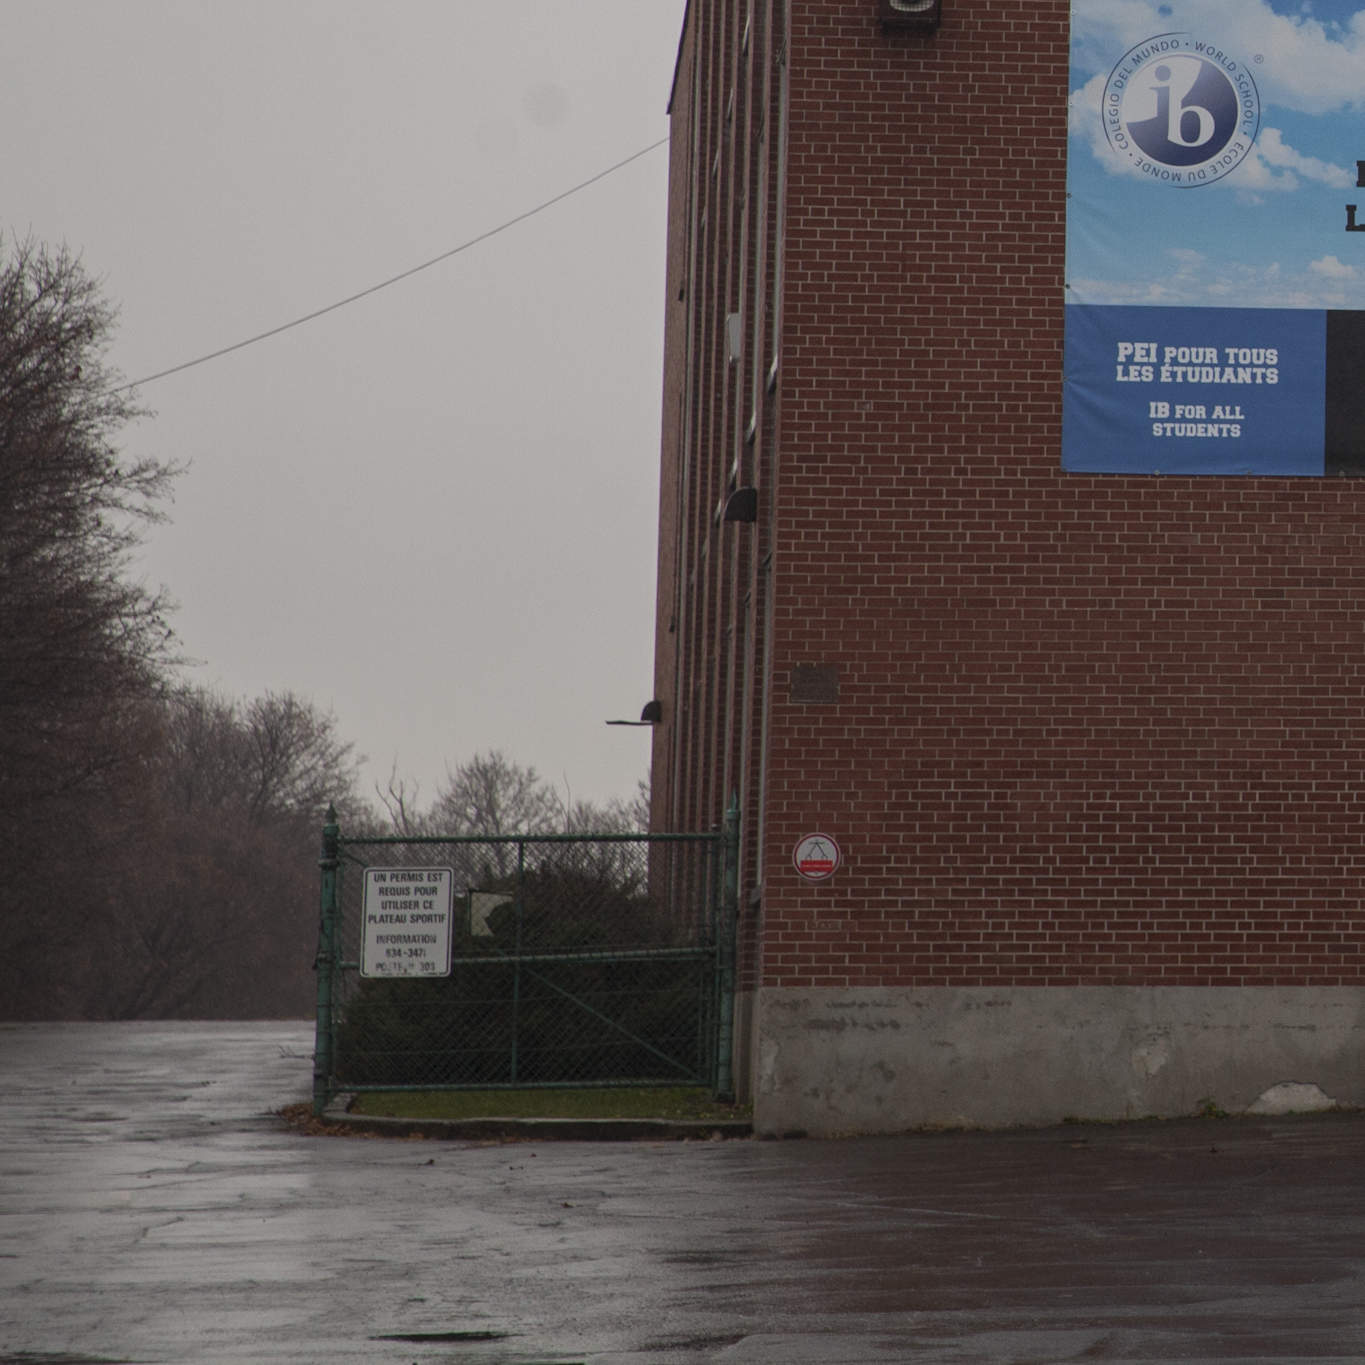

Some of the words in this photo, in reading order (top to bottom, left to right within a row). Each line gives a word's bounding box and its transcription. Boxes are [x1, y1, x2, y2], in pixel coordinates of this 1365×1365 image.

[1131, 39, 1180, 66] MUNDO
[1113, 65, 1133, 89] DEL
[1195, 41, 1237, 72] WORLD
[1234, 74, 1254, 125] SCHOOL
[1148, 64, 1216, 148] ib
[1108, 93, 1129, 150] COLEGIO
[1210, 141, 1244, 174] ÉCOLE
[1134, 157, 1182, 182] MONDE
[1187, 169, 1207, 182] DU
[1117, 342, 1158, 363] PEI
[1164, 346, 1219, 364] POUR
[1225, 347, 1279, 365] TOUS
[1116, 365, 1154, 382] LES
[1160, 363, 1279, 384] ÉTUDIANTS
[1149, 401, 1170, 419] IB
[1174, 405, 1207, 419] FOR
[1211, 406, 1245, 420] ALL
[1152, 422, 1242, 437] STUDENTS
[373, 873, 387, 883] UN
[390, 872, 424, 883] PERMIS
[427, 872, 443, 882] EST
[378, 886, 411, 896] REQUIS
[414, 886, 438, 896] POUR
[381, 900, 420, 910] UTILISER
[422, 900, 434, 910] CE
[368, 914, 407, 924] PLATEAU
[410, 914, 446, 924] SPORTIF
[376, 934, 437, 945] INFORMATION
